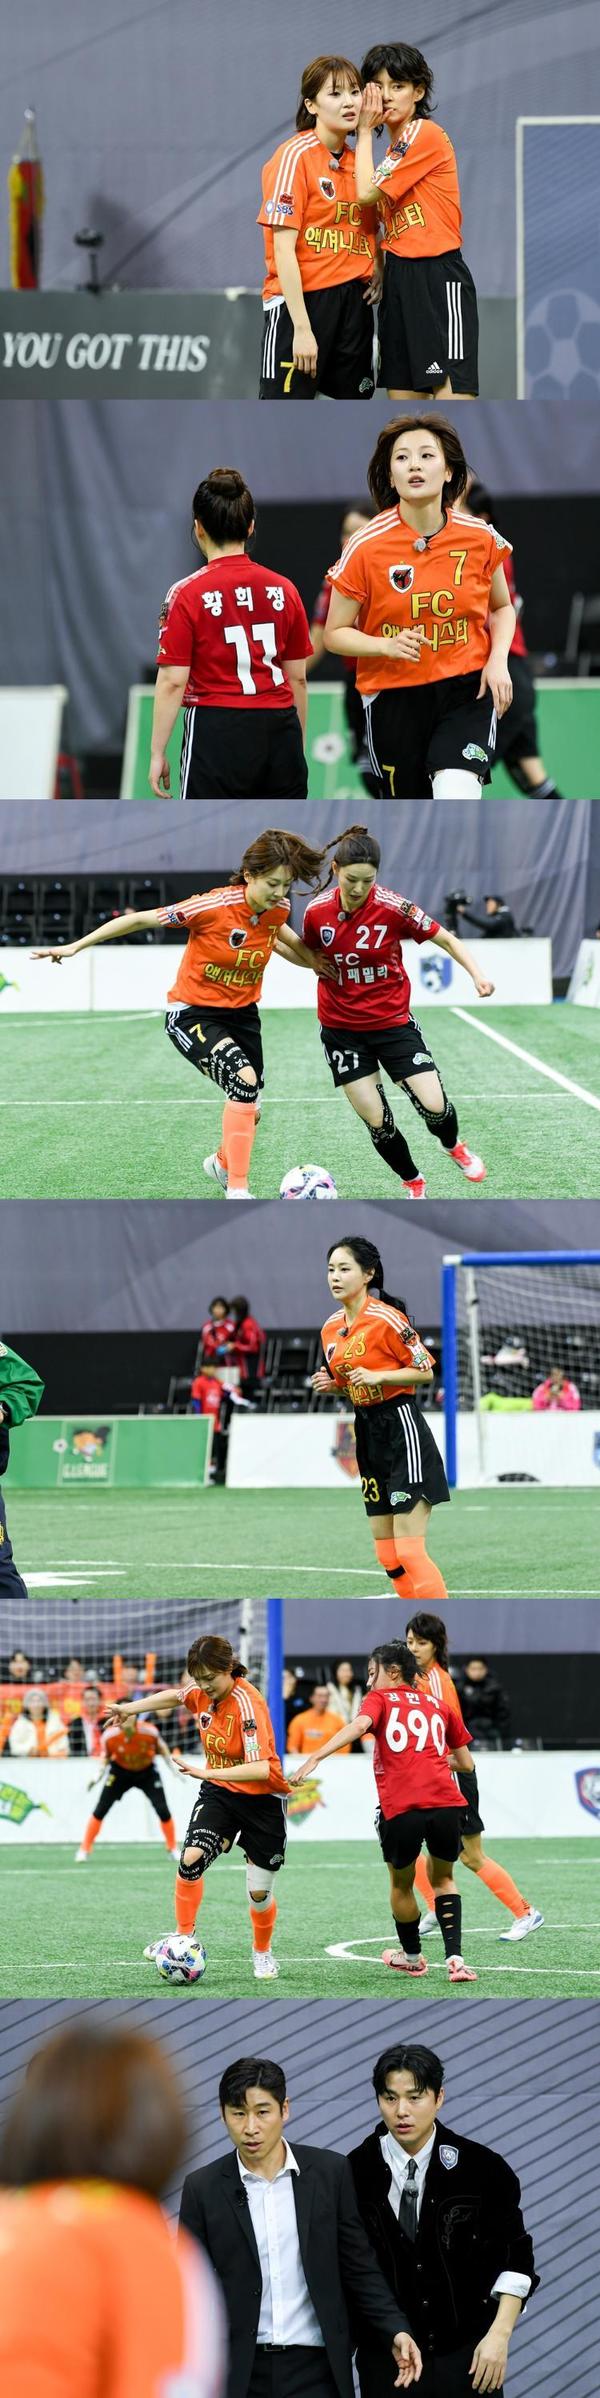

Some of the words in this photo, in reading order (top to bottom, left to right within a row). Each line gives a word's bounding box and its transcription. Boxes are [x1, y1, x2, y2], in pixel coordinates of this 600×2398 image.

[276, 204, 294, 215] SBS
[334, 201, 362, 226] FC
[3, 331, 63, 369] YOU
[65, 332, 133, 370] GOT
[137, 333, 211, 372] THIS
[280, 361, 296, 393] 7
[448, 550, 468, 585] 7
[411, 589, 455, 619] FC
[223, 622, 285, 695] 11
[381, 763, 396, 797] 7
[355, 924, 388, 950] 27
[235, 949, 265, 969] FC
[333, 952, 361, 966] FC
[188, 1023, 207, 1044] 7
[331, 1049, 360, 1074] 27
[343, 1332, 366, 1360] 23
[361, 1476, 380, 1503] 23
[225, 1714, 235, 1738] 7
[385, 1706, 447, 1757] 690
[206, 1733, 226, 1754] FC
